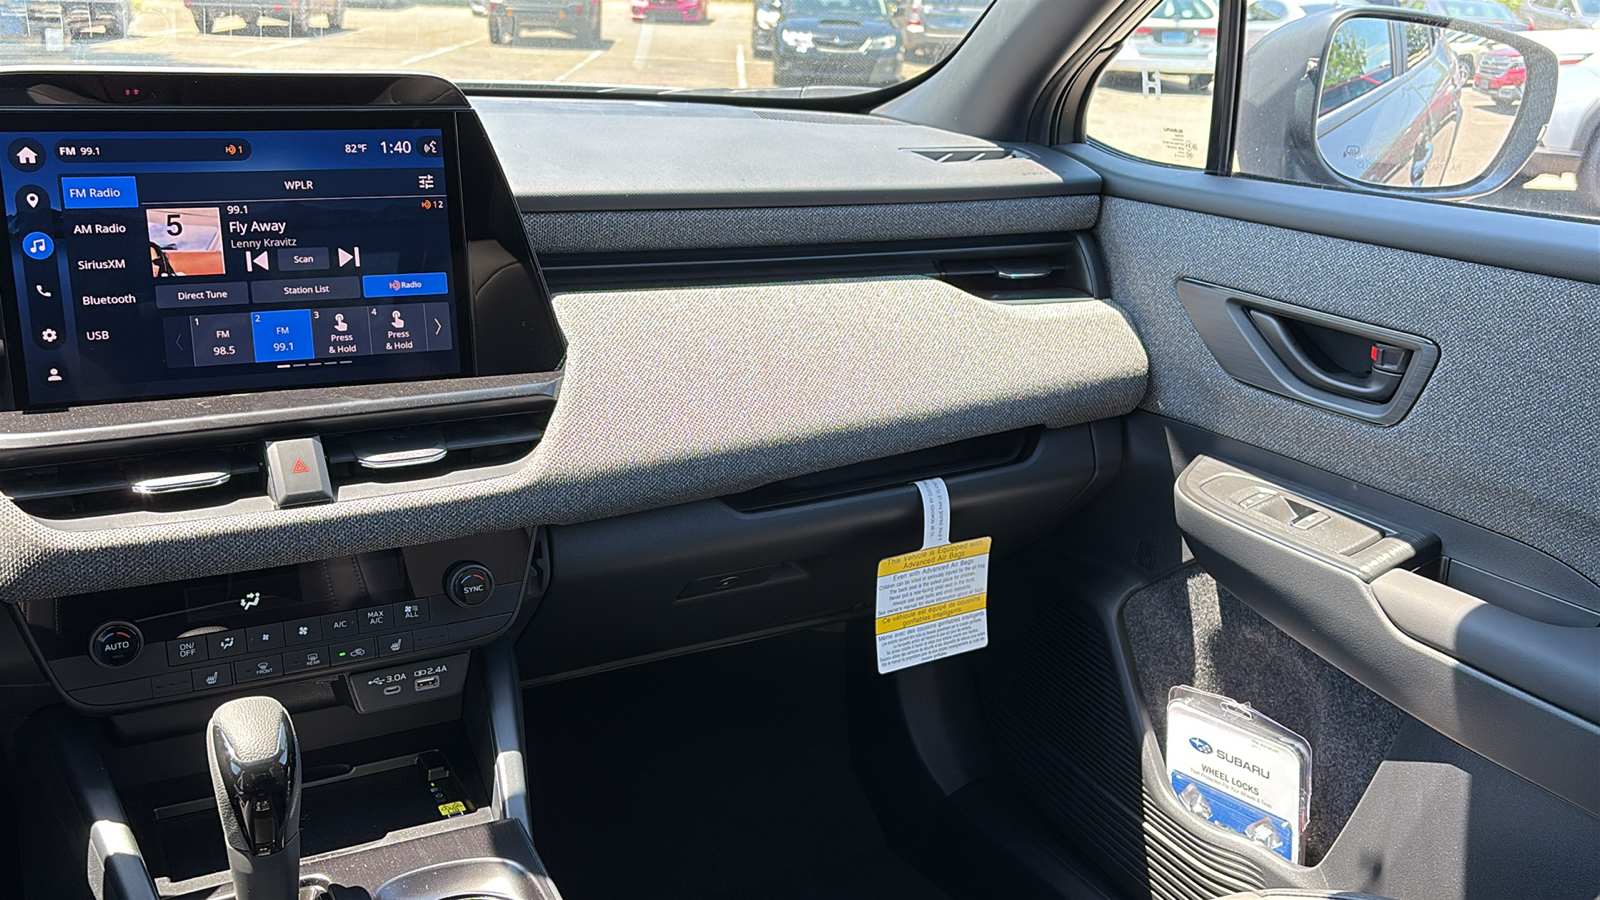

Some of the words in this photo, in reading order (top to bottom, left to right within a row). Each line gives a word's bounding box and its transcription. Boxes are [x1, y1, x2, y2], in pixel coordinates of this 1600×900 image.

[59, 147, 76, 155] FM
[80, 147, 100, 155] 99.1
[345, 143, 367, 153] 82°F
[380, 140, 412, 154] 1:40
[284, 180, 314, 190] WPLR
[69, 188, 86, 198] FM
[89, 187, 121, 198] Radio
[226, 205, 249, 214] 99.1
[73, 225, 92, 234] AM
[95, 223, 126, 234] Radio
[166, 214, 183, 236] 5
[229, 221, 247, 235] Fly
[251, 220, 286, 234] Away
[231, 238, 261, 250] Lenny
[264, 237, 297, 247] Kravitz
[77, 259, 126, 270] SiriusXM
[293, 255, 314, 264] Scan
[401, 280, 422, 289] Radio
[178, 291, 203, 300] Direct
[205, 290, 228, 299] Tune
[284, 286, 313, 295] Station
[315, 285, 330, 293] List
[82, 294, 136, 306] Bluetooth
[314, 311, 319, 319] 3
[86, 331, 110, 340] USB
[216, 330, 230, 338] FM
[331, 333, 354, 342] Press
[387, 330, 410, 339] Press
[213, 346, 236, 355] 98.5
[273, 342, 294, 351] 99.1
[337, 344, 357, 353] Hold
[386, 342, 393, 350] &
[394, 341, 413, 350] Hold
[887, 557, 900, 565] This
[903, 552, 926, 561] Vehicle
[937, 543, 967, 555] Equipped
[902, 557, 934, 568] Advanced
[949, 550, 965, 560] Bags
[893, 573, 907, 581] Even
[922, 564, 949, 574] Advanced
[960, 558, 973, 567] Bags
[463, 584, 484, 594] SYNC
[957, 597, 980, 606] coussins
[367, 610, 384, 618] MAX
[932, 607, 961, 619] intelligents
[333, 620, 347, 628] A/C
[370, 616, 384, 624] A/C
[104, 641, 130, 652] AUTO
[179, 642, 195, 650] ON/
[180, 649, 196, 657] OFF
[427, 665, 447, 675] 2.4A
[386, 673, 407, 683] 3.0A
[1216, 748, 1271, 780] SUBARU
[1201, 764, 1230, 783] WHEEL
[1231, 776, 1260, 796] LOCKS
